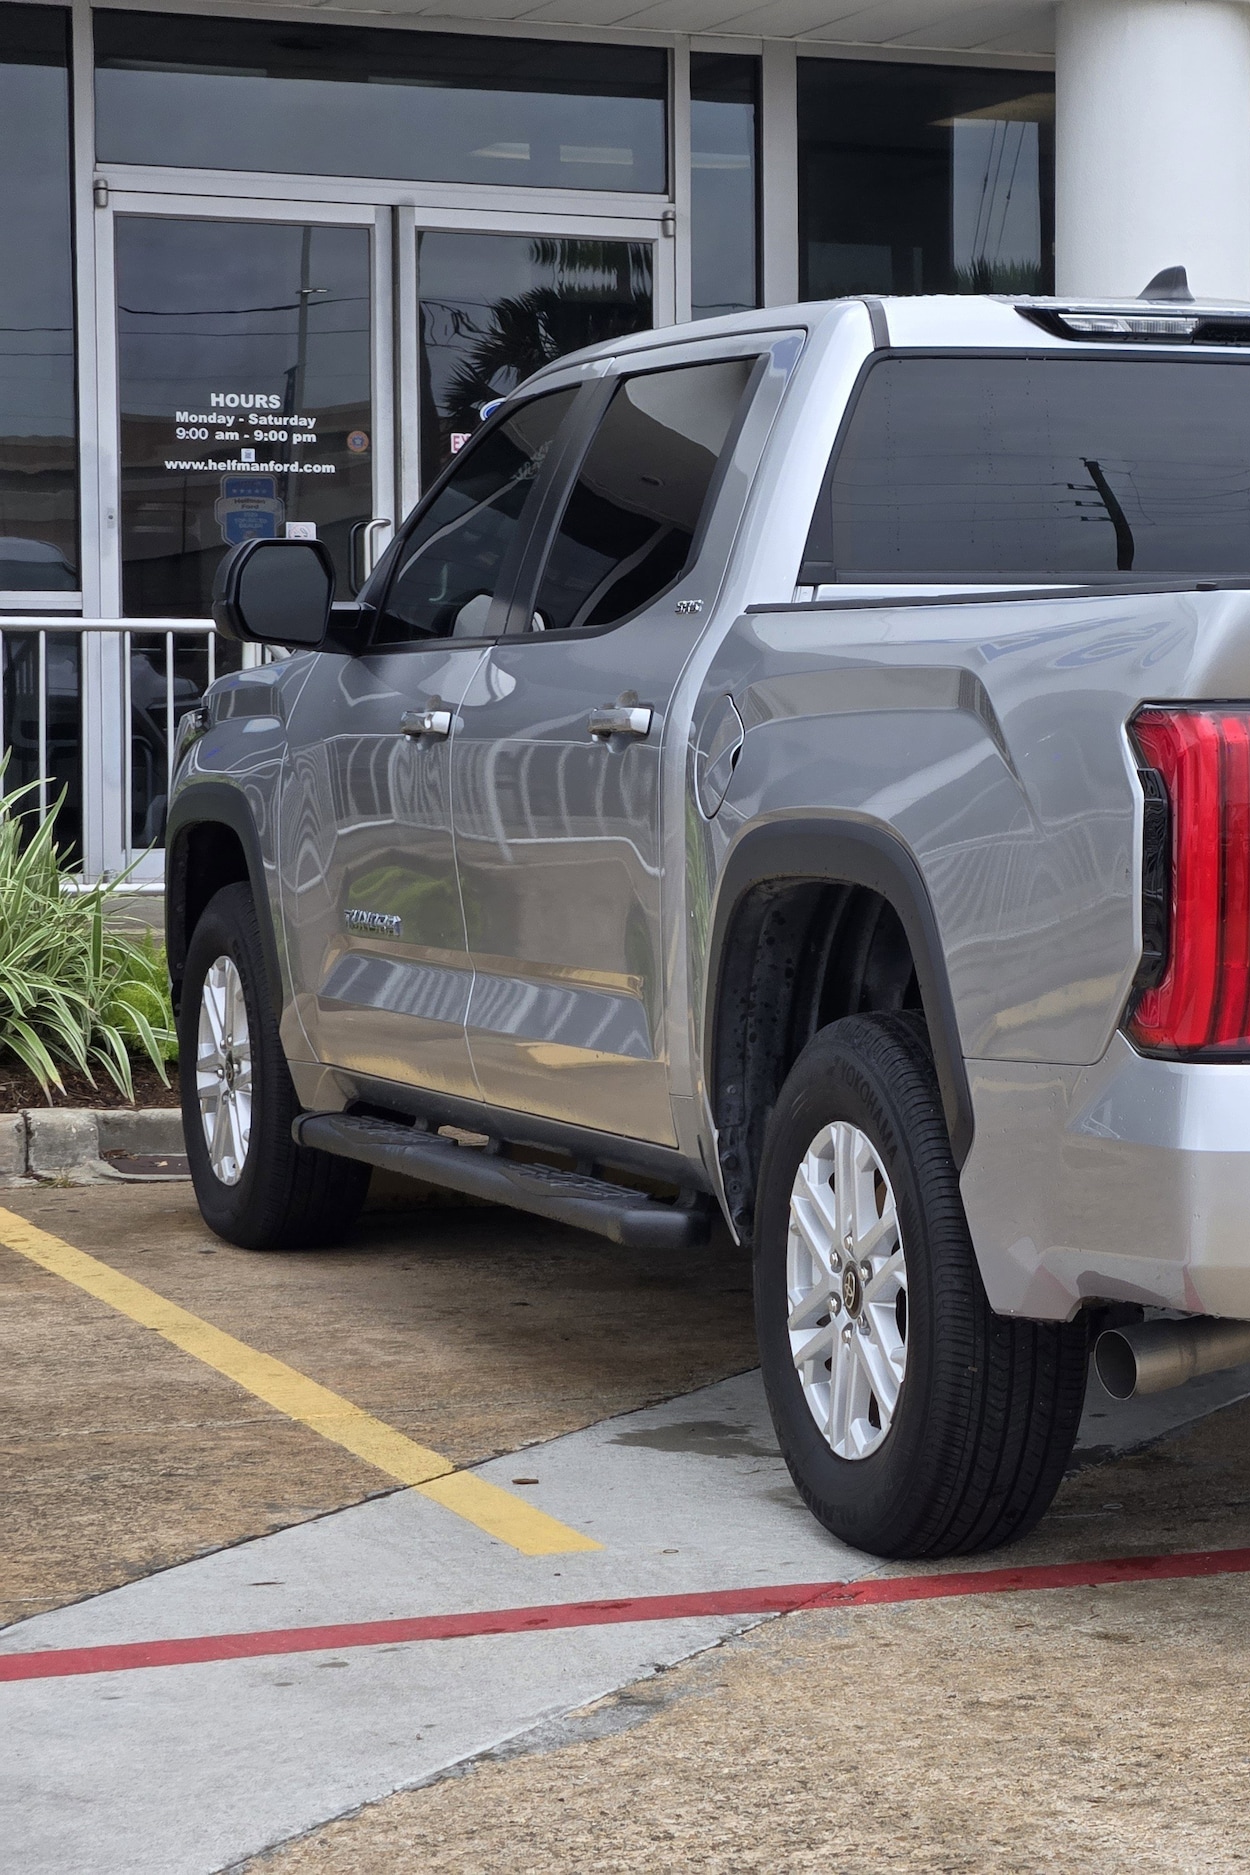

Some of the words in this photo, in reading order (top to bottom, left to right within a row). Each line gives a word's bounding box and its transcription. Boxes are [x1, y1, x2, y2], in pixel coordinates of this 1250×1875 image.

[210, 392, 281, 409] HOURS
[175, 411, 235, 427] Monday
[248, 413, 317, 429] Saturday
[175, 427, 209, 441] 9:00
[214, 431, 240, 442] am
[253, 429, 288, 442] 9:00
[292, 432, 317, 444] pm
[164, 459, 336, 474] www.helfmanford.com
[343, 909, 402, 936] TUNDRA
[841, 1060, 898, 1168] YOKOHAMA
